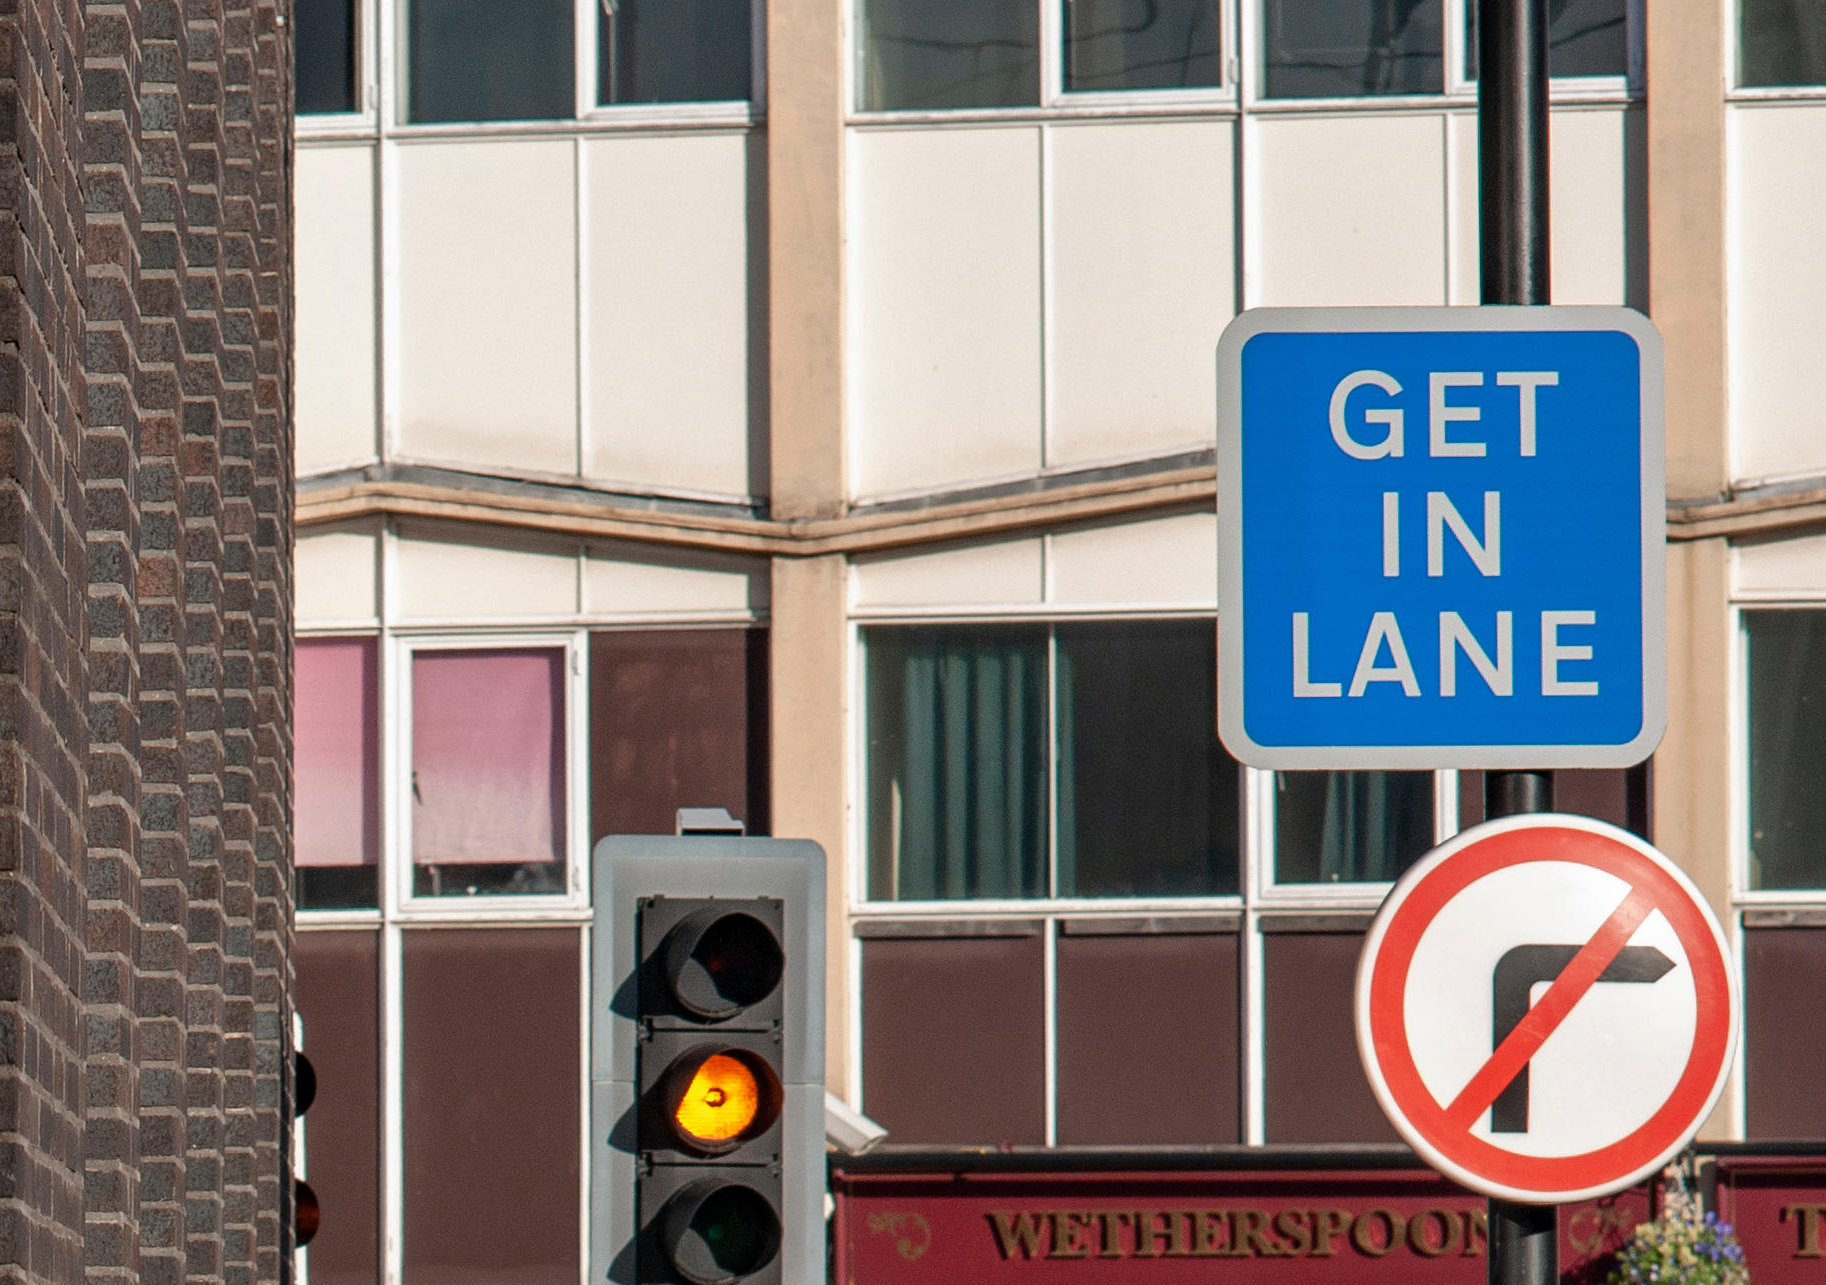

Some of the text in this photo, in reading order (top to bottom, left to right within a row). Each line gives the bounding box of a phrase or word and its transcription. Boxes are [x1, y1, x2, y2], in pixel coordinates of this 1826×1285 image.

[1328, 369, 1560, 461] GET
[1383, 491, 1501, 578] IN
[1292, 610, 1599, 698] LANE
